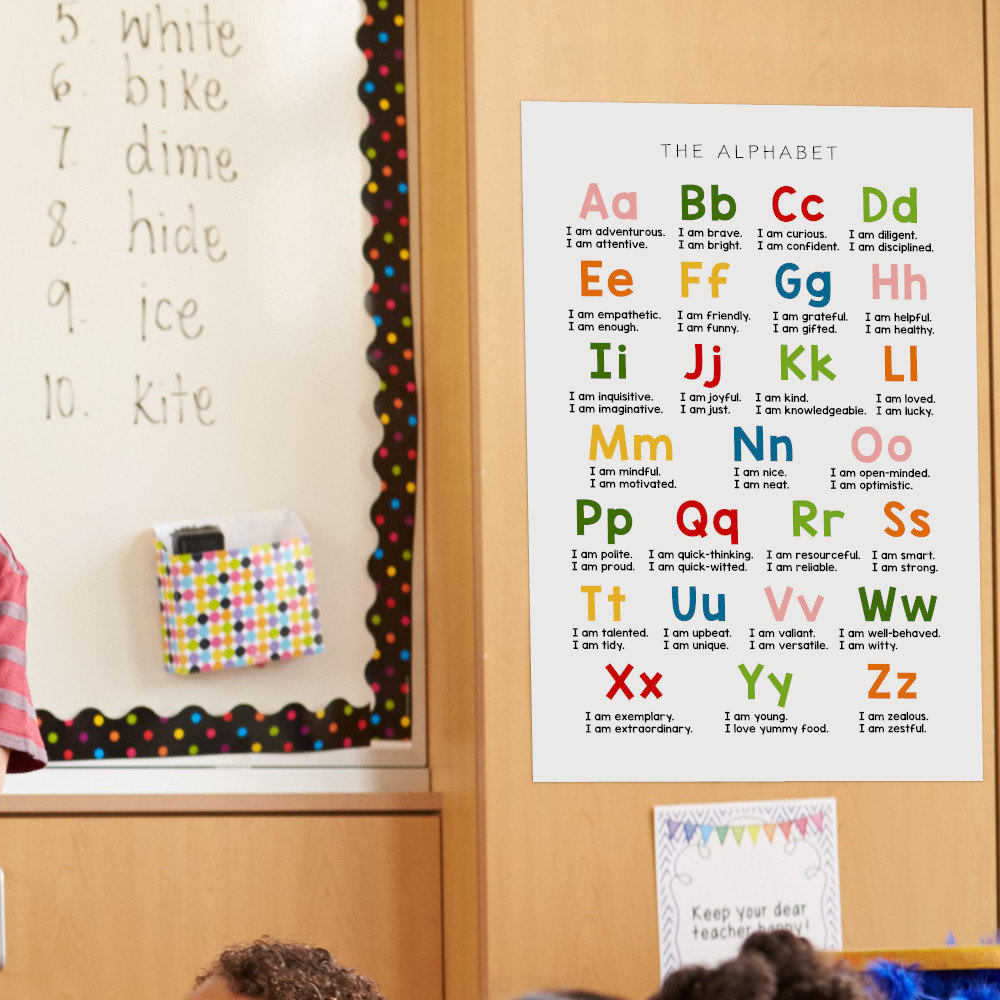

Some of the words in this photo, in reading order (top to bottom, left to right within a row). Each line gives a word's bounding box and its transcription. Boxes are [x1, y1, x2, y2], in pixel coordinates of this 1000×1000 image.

[121, 3, 243, 58] white
[123, 52, 228, 112] bike
[125, 122, 239, 183] dime
[660, 143, 703, 158] THE
[717, 144, 837, 160] ALPHABET
[579, 183, 637, 220] Aa
[681, 184, 736, 221] Bb
[772, 185, 825, 223] Cc
[862, 186, 918, 224] Dd
[48, 200, 77, 248] 8.
[127, 188, 227, 263] hide
[566, 226, 572, 236] I
[575, 228, 592, 236] am
[595, 226, 665, 237] adventurous.
[678, 227, 684, 237] I
[687, 229, 704, 237] am
[707, 228, 743, 238] brave.
[757, 228, 763, 238] I
[766, 230, 783, 238] am
[786, 229, 827, 239] curious.
[849, 229, 855, 239] I
[878, 230, 917, 242] diligent.
[849, 242, 855, 251] I
[858, 244, 875, 252] am
[878, 242, 934, 254] disciplined.
[580, 260, 634, 297] Ee
[680, 261, 731, 299] Ff
[775, 262, 831, 308] Gg
[872, 264, 927, 300] Hh
[47, 279, 86, 334] 9.
[142, 282, 204, 342] ice
[568, 309, 574, 319] I
[577, 311, 594, 319] am
[597, 310, 661, 321] empathetic.
[677, 310, 683, 320] I
[686, 312, 703, 320] am
[706, 311, 751, 322] friendly.
[773, 311, 779, 321] I
[782, 313, 799, 321] am
[802, 312, 848, 323] grateful.
[865, 312, 871, 322] I
[874, 314, 891, 322] am
[894, 312, 932, 324] helpful.
[590, 342, 626, 379] Ii
[683, 343, 721, 389] Jj
[780, 344, 837, 381] Kk
[883, 345, 918, 382] Ll
[45, 373, 89, 420] 10.
[133, 372, 216, 427] kite
[569, 391, 575, 401] I
[578, 393, 595, 401] am
[598, 392, 653, 403] inquisitive.
[680, 392, 686, 402] I
[689, 394, 706, 402] am
[707, 392, 742, 404] joyful.
[755, 392, 761, 402] I
[784, 393, 809, 403] kind.
[876, 394, 882, 403] I
[905, 394, 936, 403] loved.
[755, 405, 762, 415] I
[764, 407, 781, 415] am
[784, 405, 867, 417] knowledgeable.
[589, 424, 673, 462] Mm
[733, 425, 794, 461] Nn
[851, 426, 912, 463] Oo
[590, 466, 596, 476] I
[599, 468, 616, 476] am
[619, 467, 661, 476] mindful.
[734, 467, 740, 477] I
[743, 469, 760, 477] am
[763, 468, 787, 477] nice.
[830, 467, 836, 477] I
[859, 468, 930, 479] open-minded.
[590, 478, 596, 488] I
[619, 479, 677, 489] motivated.
[576, 499, 633, 545] Pp
[676, 500, 739, 545] Qq
[792, 500, 845, 538] Rr
[883, 500, 931, 538] Ss
[571, 549, 578, 559] I
[580, 551, 598, 559] am
[601, 549, 633, 561] polite.
[648, 549, 654, 559] I
[657, 551, 674, 559] am
[677, 550, 754, 561] quick-thinking.
[767, 550, 772, 559] I
[795, 550, 861, 560] resourceful.
[872, 550, 878, 560] I
[881, 552, 898, 560] am
[900, 551, 935, 560] smart.
[648, 561, 655, 571] I
[678, 562, 747, 573] quick-witted.
[580, 585, 626, 622] Tt
[671, 586, 726, 622] Uu
[764, 586, 824, 622] Vv
[858, 586, 938, 622] Ww
[572, 628, 578, 637] I
[601, 628, 649, 638] talented.
[663, 628, 669, 638] I
[672, 630, 689, 638] am
[692, 628, 732, 640] upbeat.
[749, 628, 755, 638] I
[758, 630, 775, 638] am
[778, 628, 816, 638] valiant.
[839, 628, 845, 638] I
[848, 630, 864, 638] am
[868, 628, 941, 638] well-behaved.
[605, 663, 663, 700] Xx
[738, 663, 793, 708] Yy
[867, 663, 917, 700] Zz
[585, 711, 591, 721] I
[594, 713, 611, 721] am
[614, 711, 674, 723] exemplary.
[724, 711, 731, 721] I
[733, 713, 750, 721] am
[754, 713, 788, 723] young.
[859, 711, 865, 721] I
[868, 713, 885, 721] am
[888, 711, 929, 721] zealous.
[586, 724, 591, 733] I
[614, 724, 693, 735] extraordinary.
[725, 723, 731, 733] I
[733, 724, 756, 733] love
[759, 726, 798, 735] yummy
[801, 723, 829, 733] food.
[691, 905, 731, 923] Keep
[736, 905, 767, 921] your
[774, 902, 807, 917] dear
[692, 924, 752, 941] teacher
